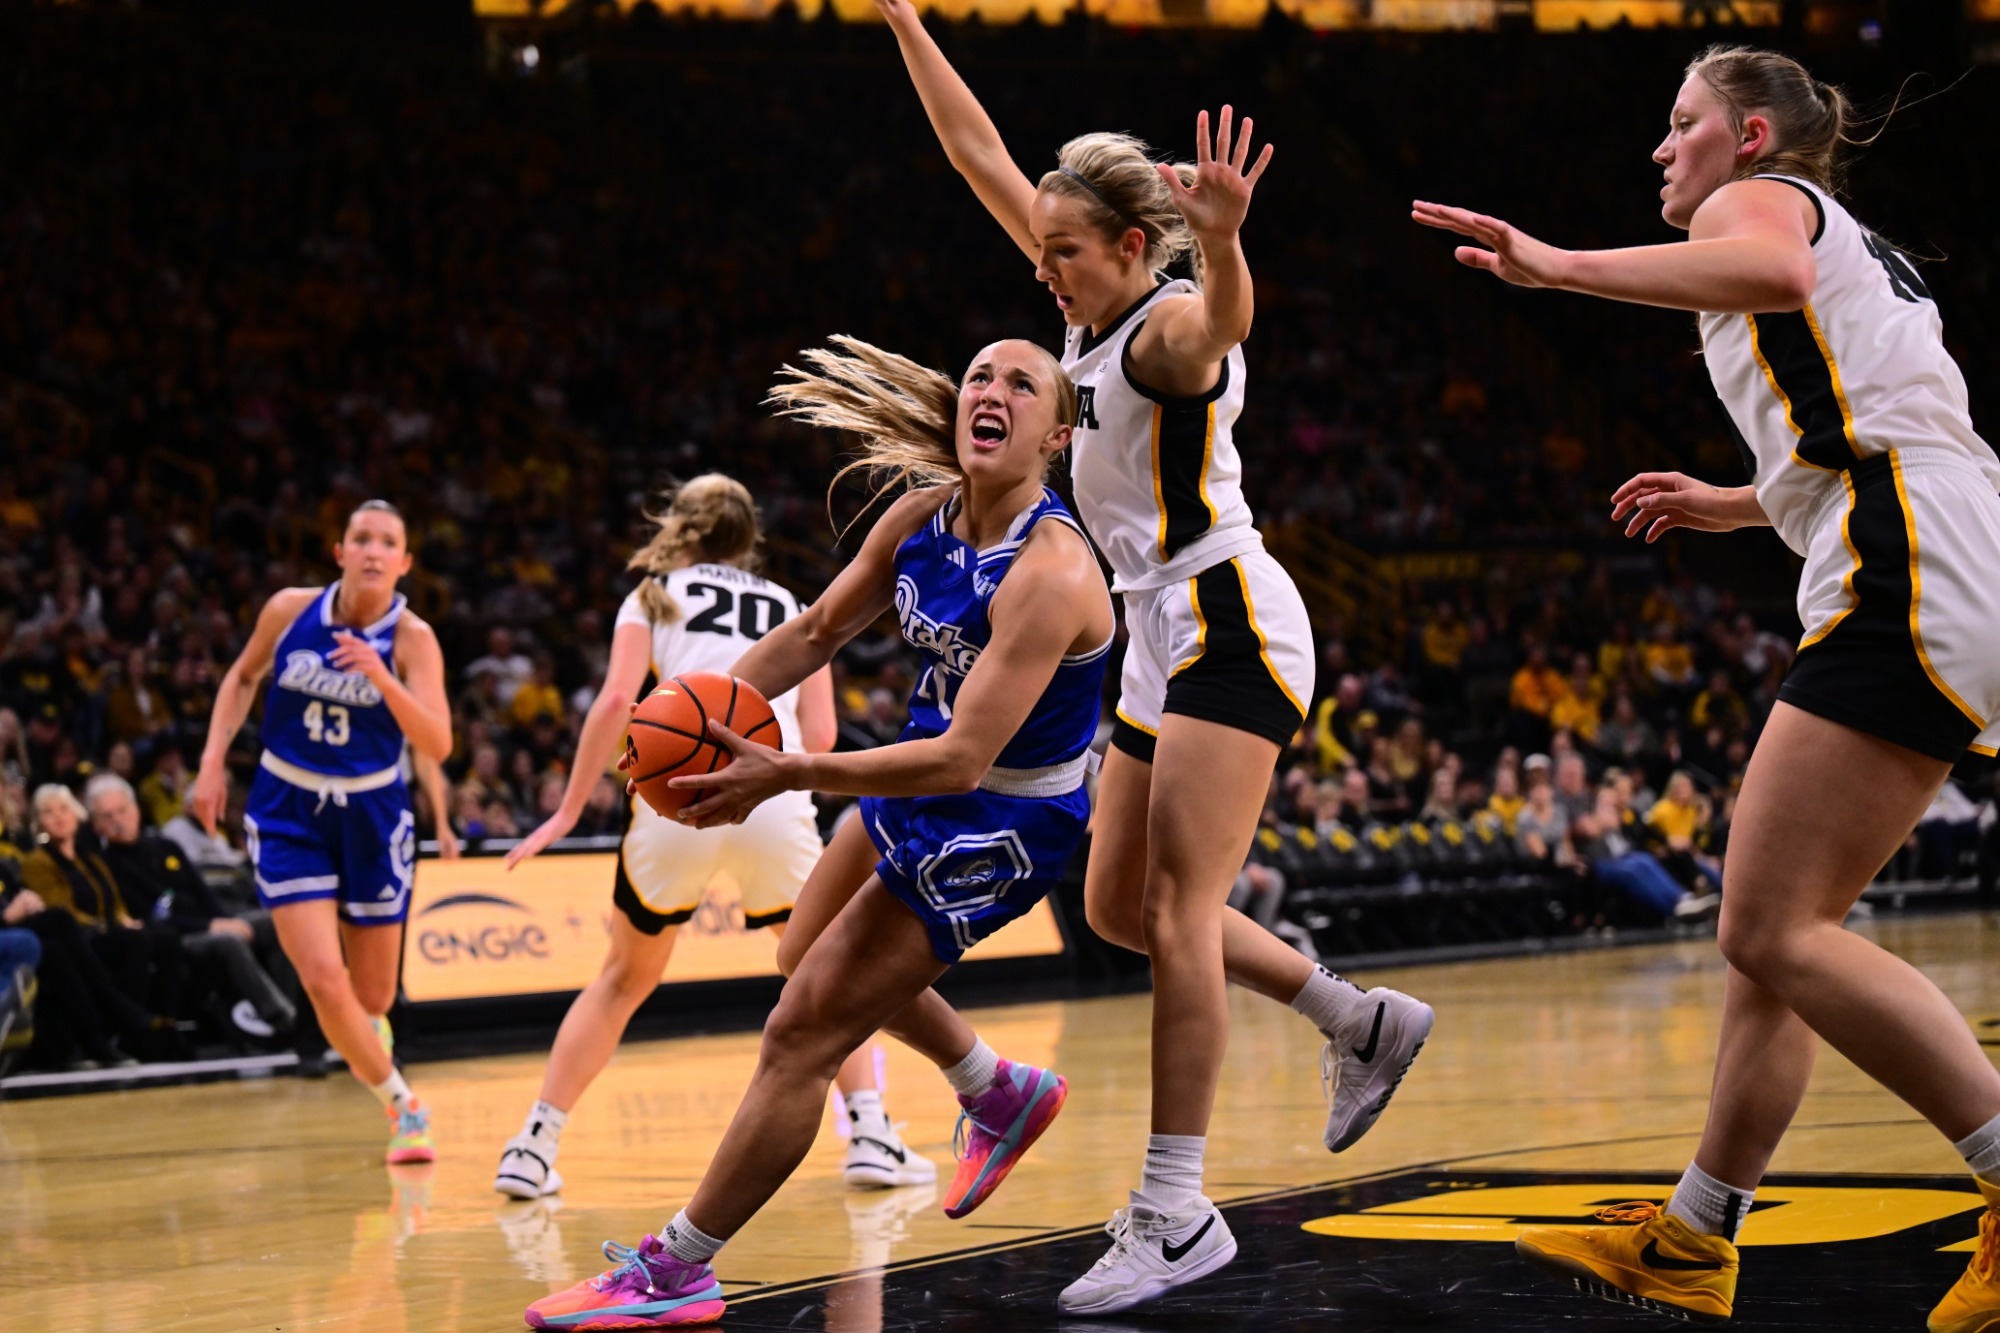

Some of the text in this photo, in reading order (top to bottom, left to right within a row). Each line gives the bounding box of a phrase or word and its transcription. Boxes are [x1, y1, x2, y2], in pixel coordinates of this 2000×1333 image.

[686, 582, 785, 641] 20
[895, 574, 984, 679] Drake
[277, 649, 384, 707] Drake
[303, 700, 350, 745] 43
